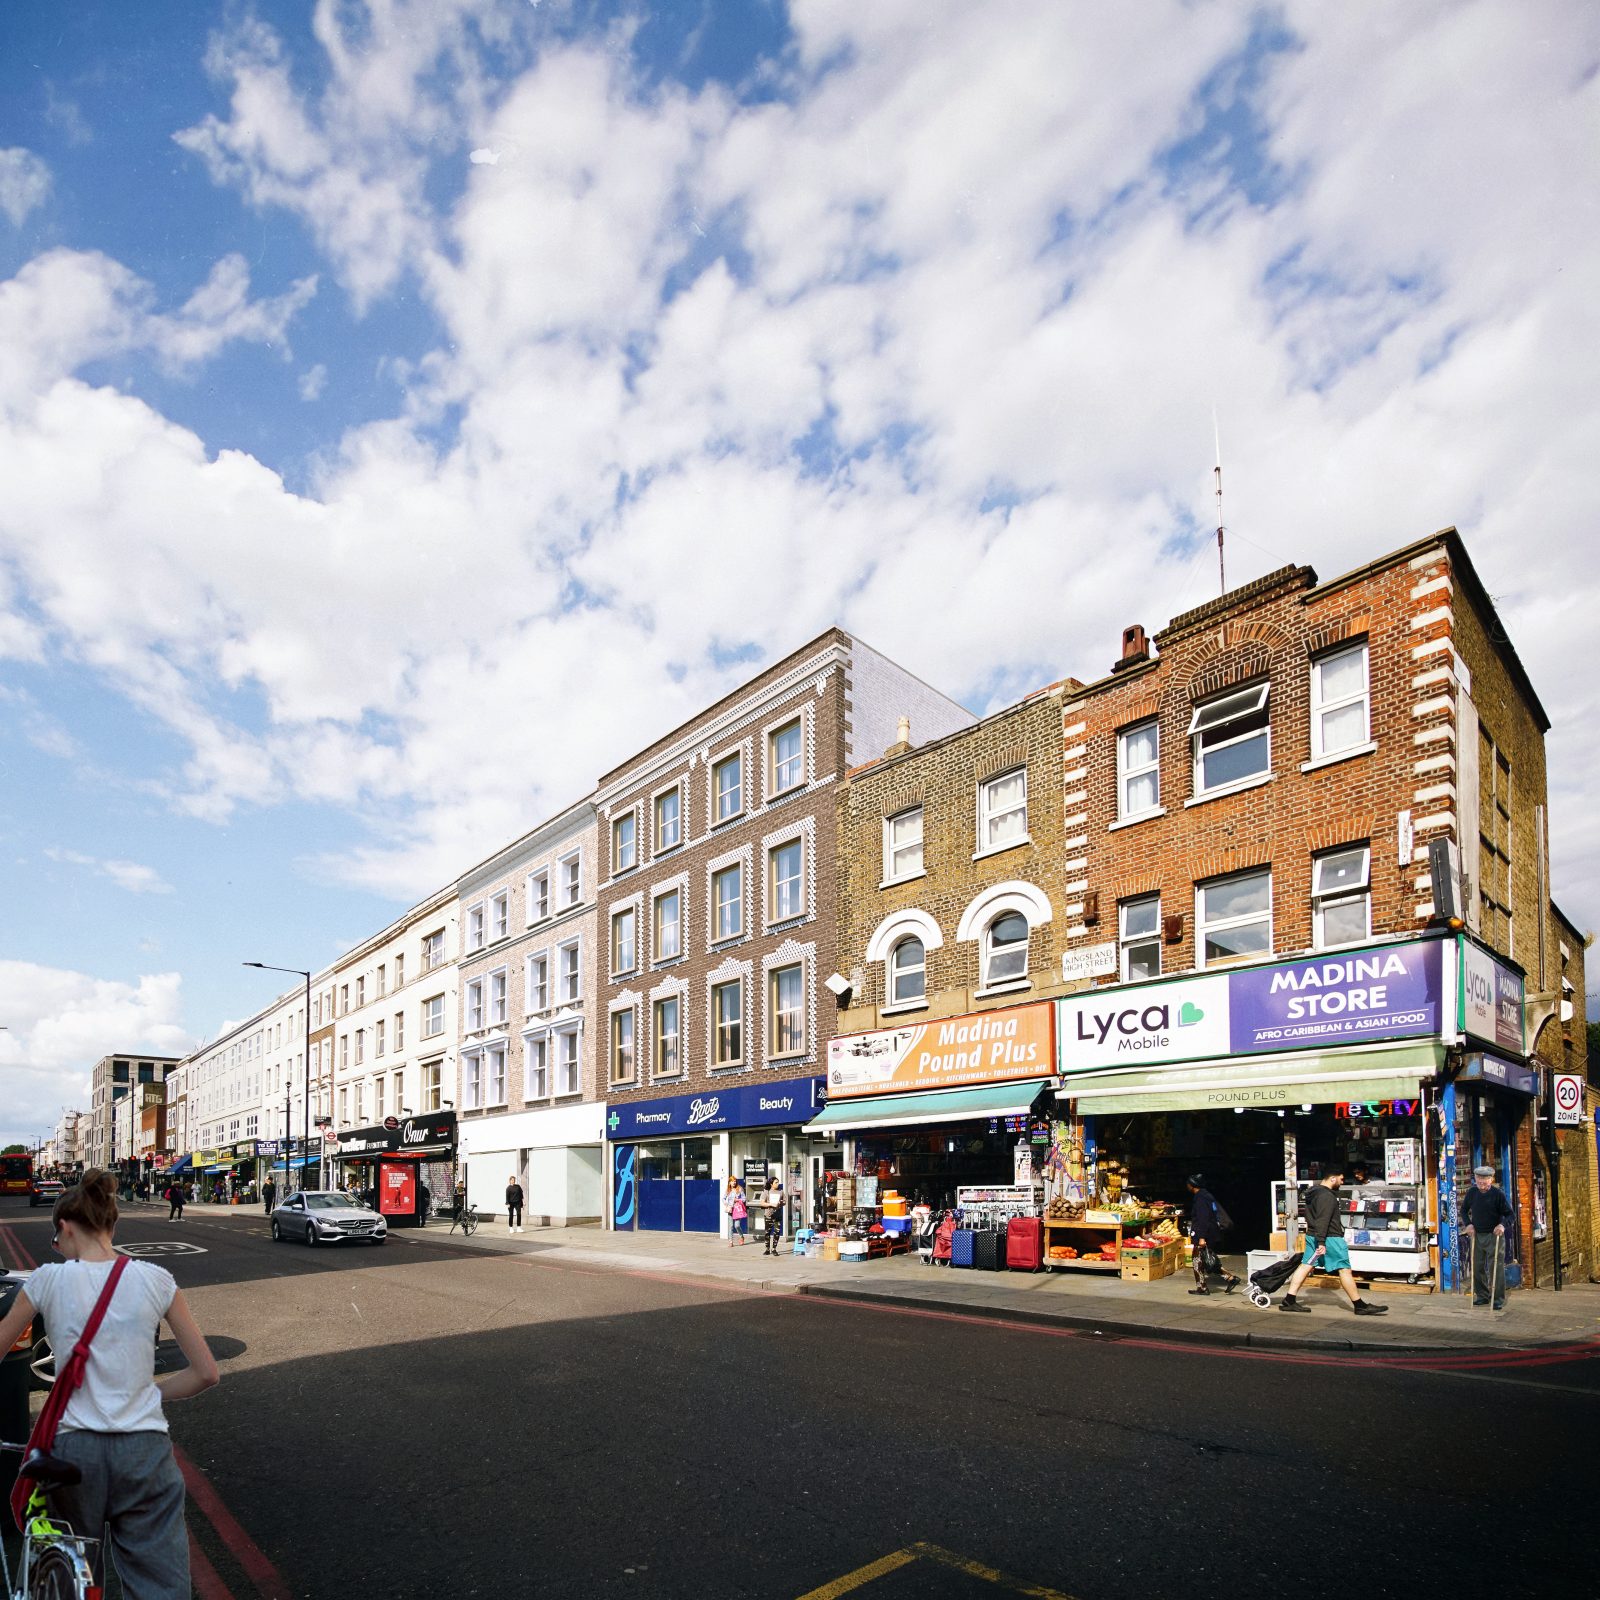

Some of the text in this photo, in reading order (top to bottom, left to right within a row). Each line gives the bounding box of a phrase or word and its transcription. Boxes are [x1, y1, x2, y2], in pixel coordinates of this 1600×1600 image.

[1065, 949, 1113, 965] KINGSLAND
[1064, 962, 1083, 972] HIGH
[1269, 953, 1408, 994] MADINA
[1465, 960, 1486, 1001] Lyca
[1499, 974, 1520, 1002] MADINA
[1287, 985, 1388, 1019] STORE
[1474, 1004, 1487, 1018] Mobile
[1502, 1001, 1518, 1025] STORE
[938, 1016, 1018, 1047] Madina
[1077, 1004, 1170, 1045] Lyca
[1255, 1013, 1426, 1041] AFRO CARIBBEAN & ASIAN FOOD
[1117, 1035, 1170, 1052] Mobile
[918, 1043, 1038, 1074] Pound Plus
[946, 1071, 988, 1082] KITCHENWARE
[993, 1066, 1029, 1077] TOILETRIES
[1035, 1064, 1047, 1073] DIY
[1208, 1089, 1286, 1103] POUND PLUS
[1560, 1086, 1576, 1101] 20
[686, 1096, 720, 1125] Boots
[760, 1096, 793, 1112] Beauty
[636, 1112, 671, 1124] Pharmacy
[1557, 1112, 1577, 1121] ZONE
[127, 1244, 188, 1253] 20
